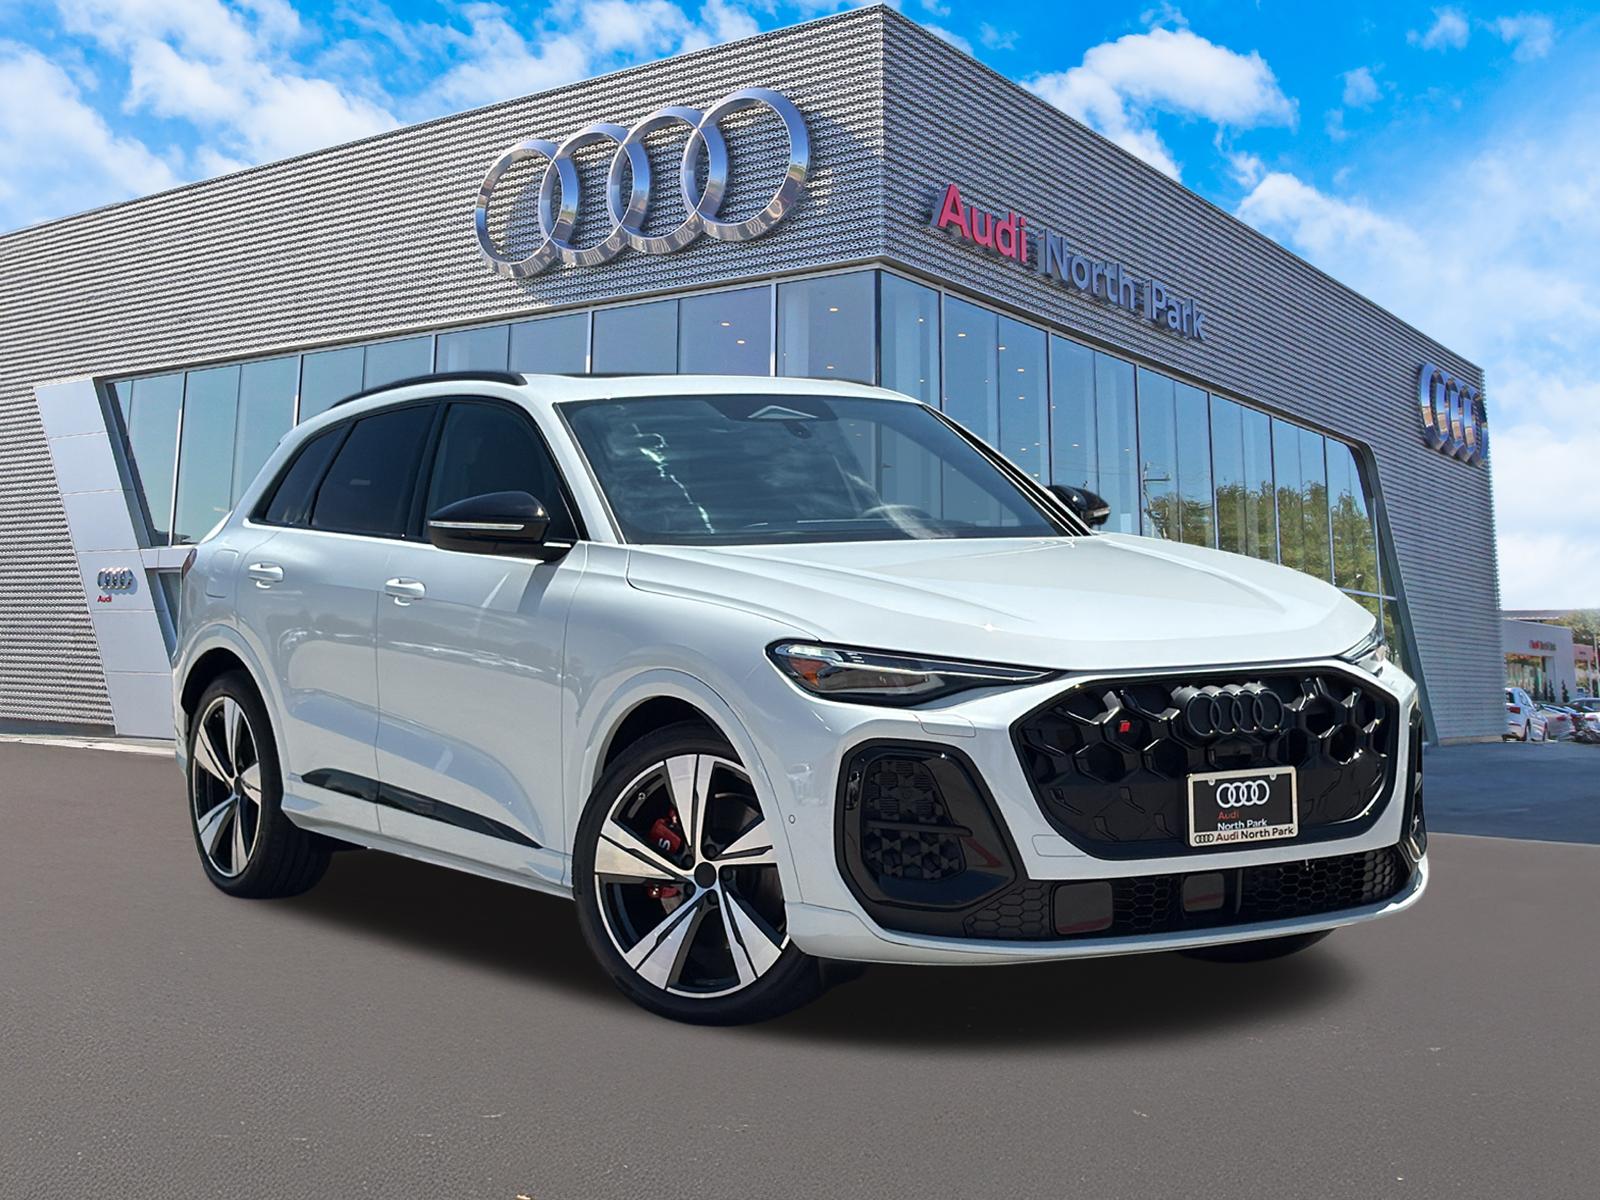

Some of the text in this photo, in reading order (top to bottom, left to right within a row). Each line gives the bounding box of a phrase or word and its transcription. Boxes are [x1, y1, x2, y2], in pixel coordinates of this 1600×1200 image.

[934, 183, 1206, 340] Audi North Park
[1218, 811, 1240, 819] Audi
[1217, 818, 1267, 831] North Park
[1216, 826, 1294, 842] Audi North Park
[658, 838, 671, 850] S
